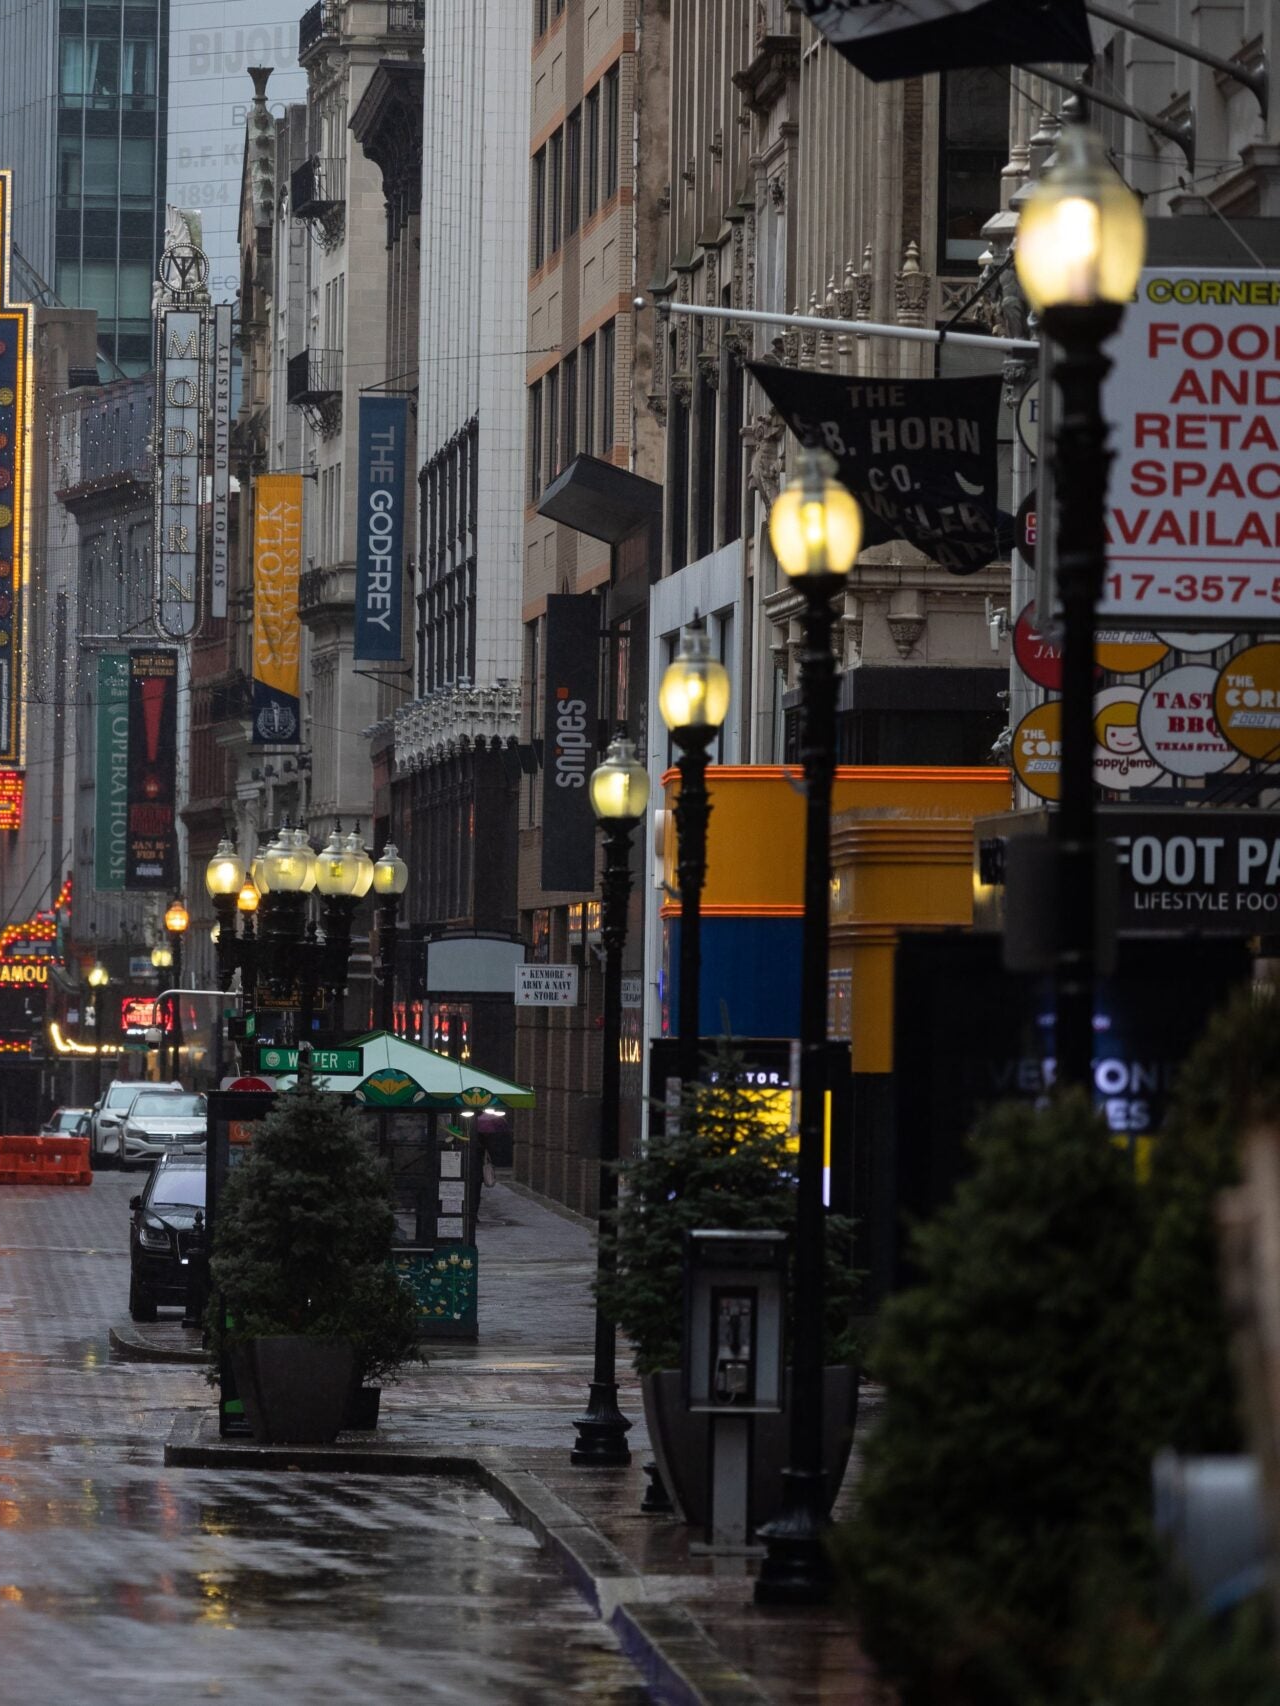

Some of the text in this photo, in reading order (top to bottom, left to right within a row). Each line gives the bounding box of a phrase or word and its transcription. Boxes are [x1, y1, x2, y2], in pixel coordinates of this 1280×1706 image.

[178, 183, 230, 207] 1894
[846, 385, 907, 408] THE
[872, 416, 981, 455] HORN
[166, 329, 198, 601] MODERN
[214, 343, 229, 587] SUFFOLK UNIVERSITY
[366, 425, 395, 632] THE GODFREY
[1104, 508, 1280, 547] VAILA
[258, 501, 282, 666] SUFFOLK
[282, 501, 300, 666] UNIVERSITY
[1226, 675, 1255, 688] THE
[1153, 692, 1214, 710] TAST
[1225, 688, 1280, 708] COR
[1022, 729, 1046, 740] THE
[1168, 716, 1220, 738] BBQ
[556, 700, 592, 788] snipes
[1155, 742, 1194, 752] TEXAS
[109, 716, 128, 880] OPERA HOUSE
[1134, 890, 1230, 911] LIFESTYLE
[530, 968, 565, 979] KENMORE
[522, 980, 543, 990] ARMY
[553, 981, 572, 990] NAVY
[533, 991, 560, 1001] STORE
[288, 1052, 357, 1069] WTER ST
